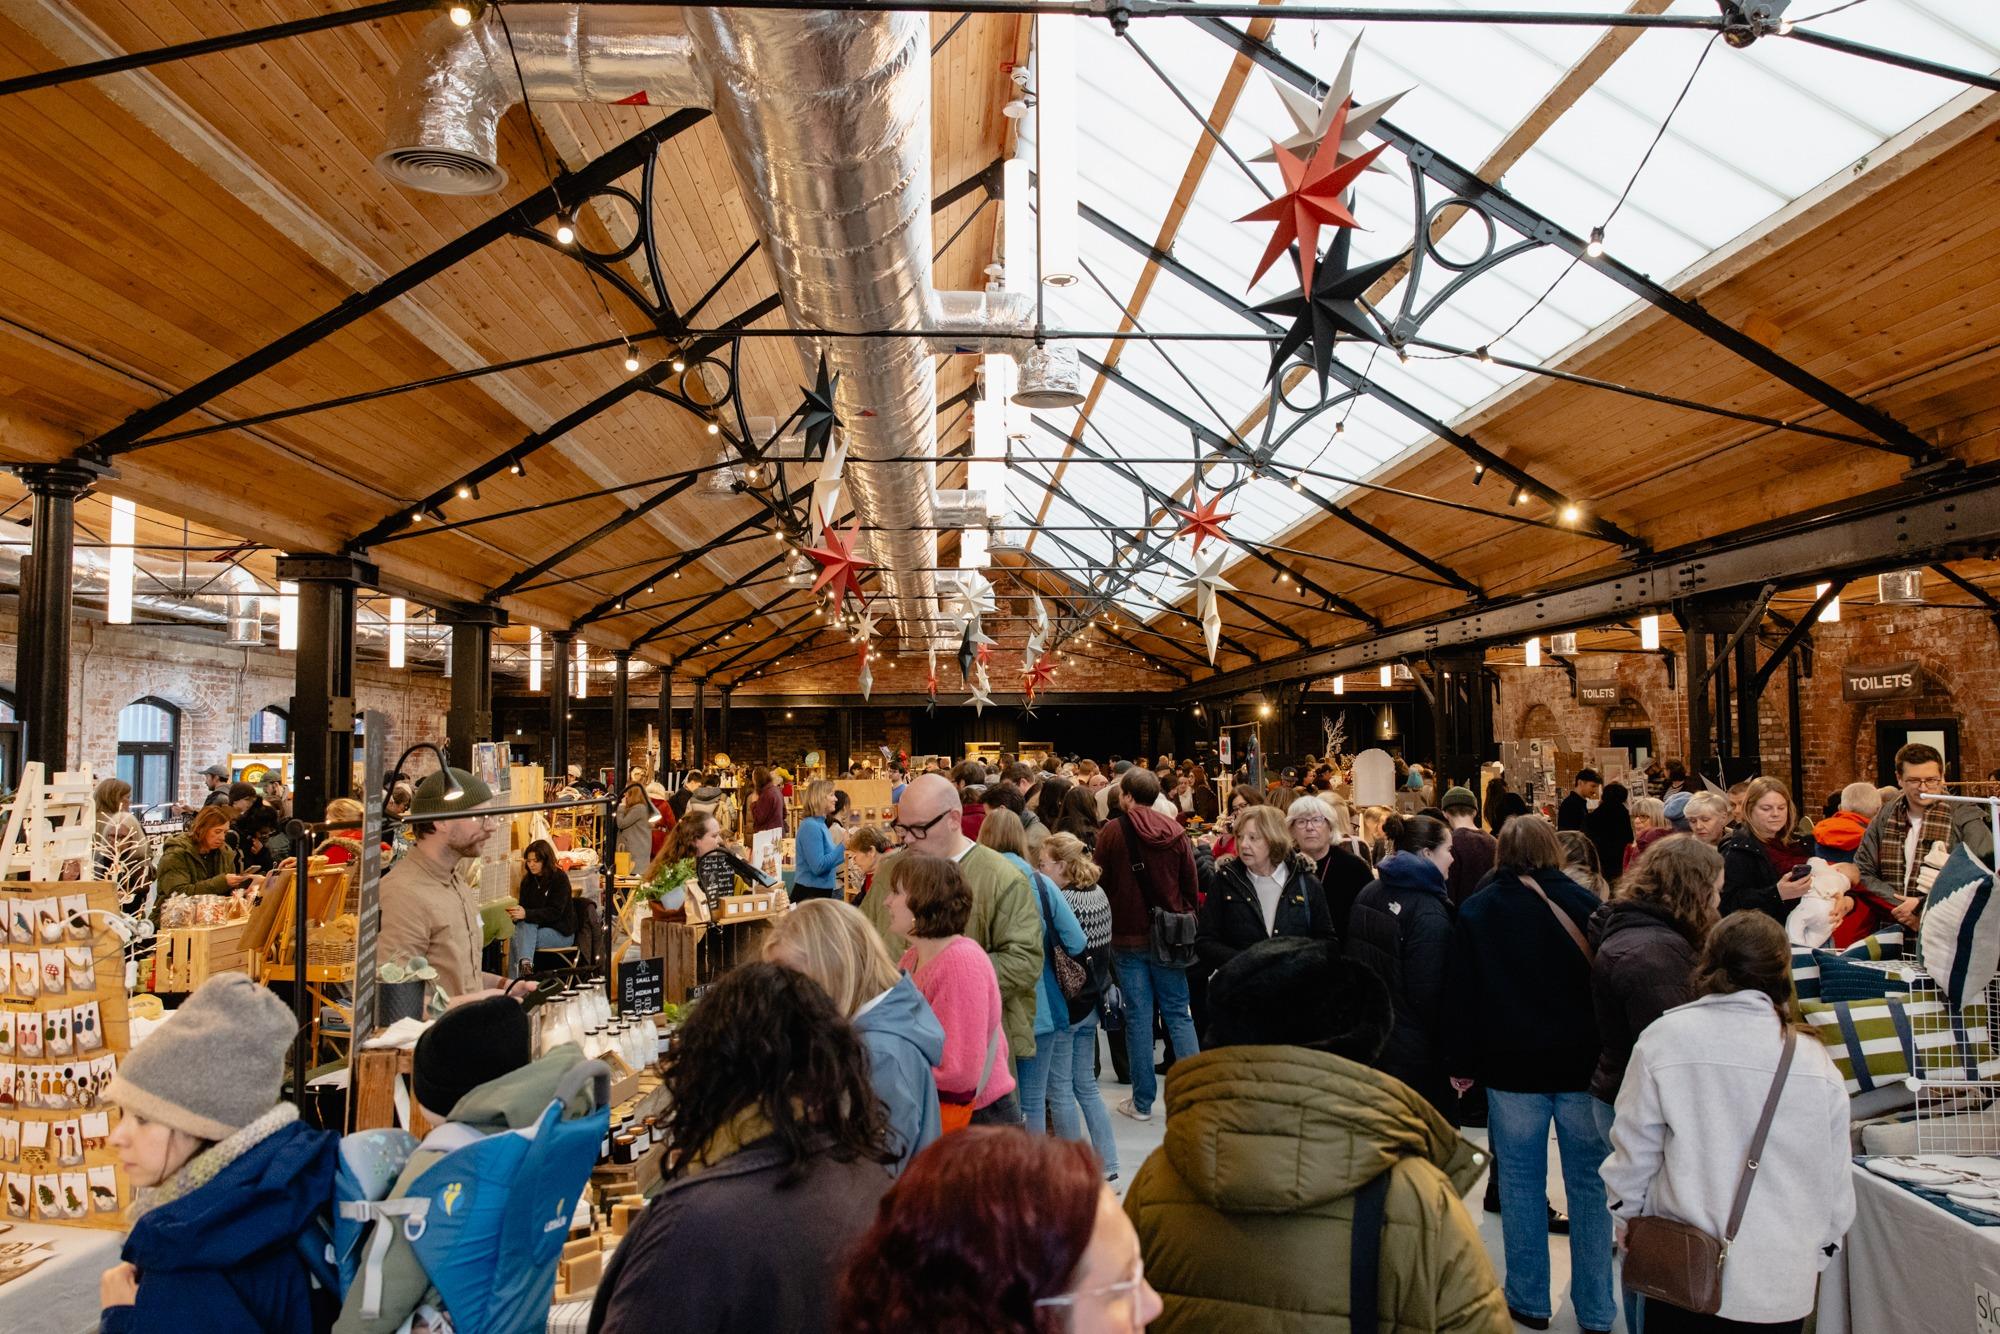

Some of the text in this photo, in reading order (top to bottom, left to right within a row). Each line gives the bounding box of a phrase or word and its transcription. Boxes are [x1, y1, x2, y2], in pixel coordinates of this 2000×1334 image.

[1850, 673, 1912, 690] TOILETS
[1582, 688, 1615, 698] TOILETS
[635, 976, 651, 984] SMALL
